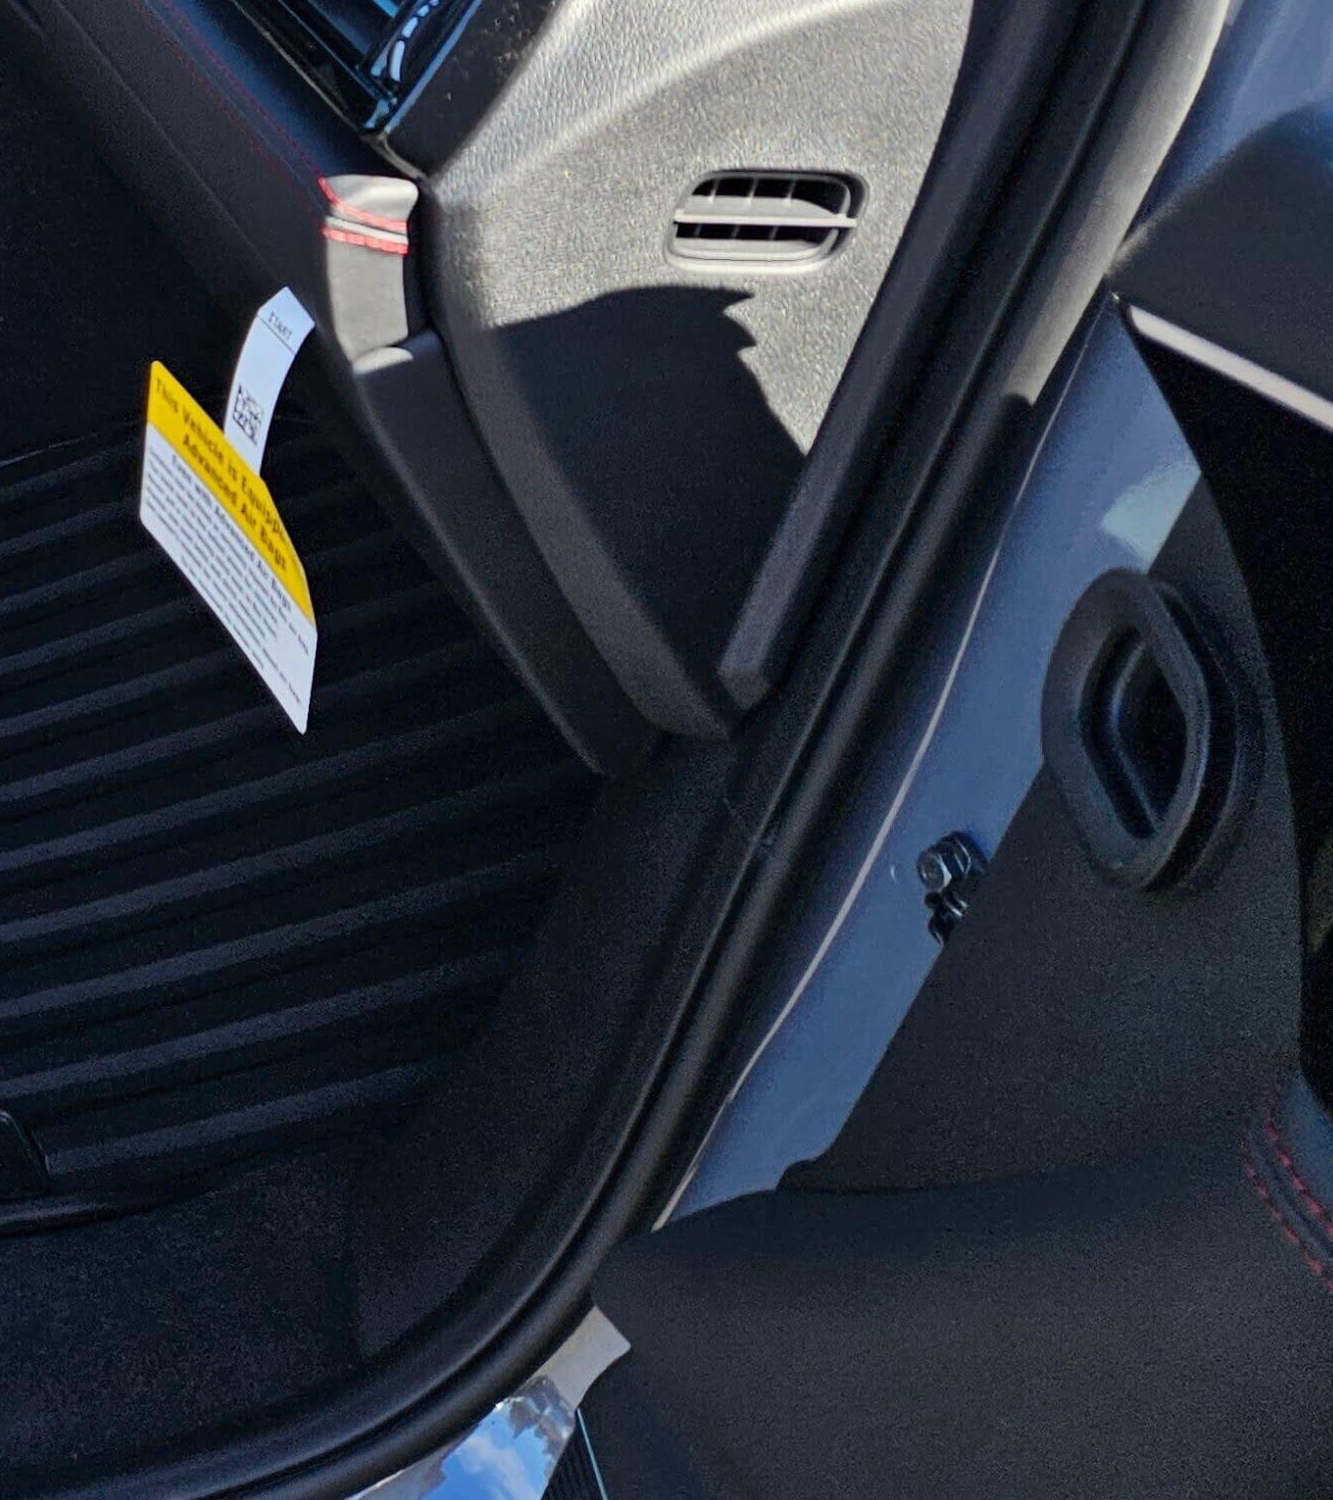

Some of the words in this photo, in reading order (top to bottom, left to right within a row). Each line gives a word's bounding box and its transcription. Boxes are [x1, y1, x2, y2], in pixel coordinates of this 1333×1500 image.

[155, 374, 178, 415] This
[182, 405, 223, 467] Vehicle
[182, 428, 237, 509] Advanced
[240, 499, 257, 531] Air
[259, 524, 286, 574] Bags
[214, 502, 254, 562] Advanced
[256, 557, 269, 582] Air
[271, 575, 291, 614] Bags
